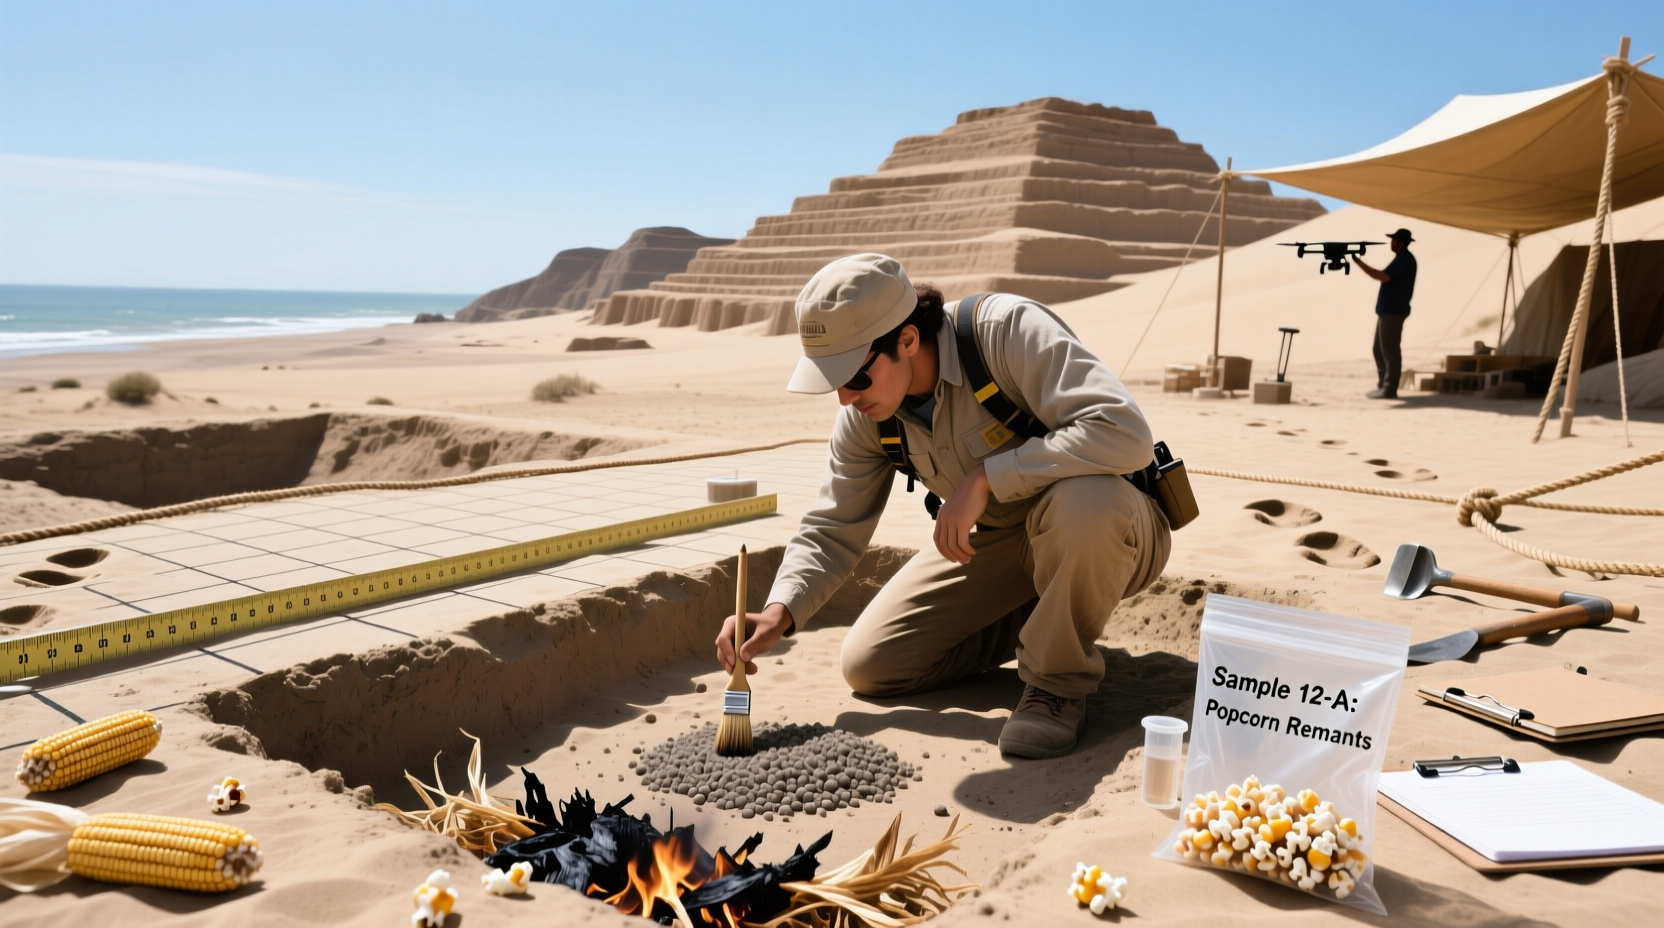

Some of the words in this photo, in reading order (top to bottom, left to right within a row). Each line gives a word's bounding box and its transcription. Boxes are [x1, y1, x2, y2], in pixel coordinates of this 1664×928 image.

[1212, 666, 1290, 699] Sample
[1300, 684, 1358, 712] 12-A:
[1205, 699, 1280, 732] Popcorn
[1286, 717, 1372, 750] Remants
